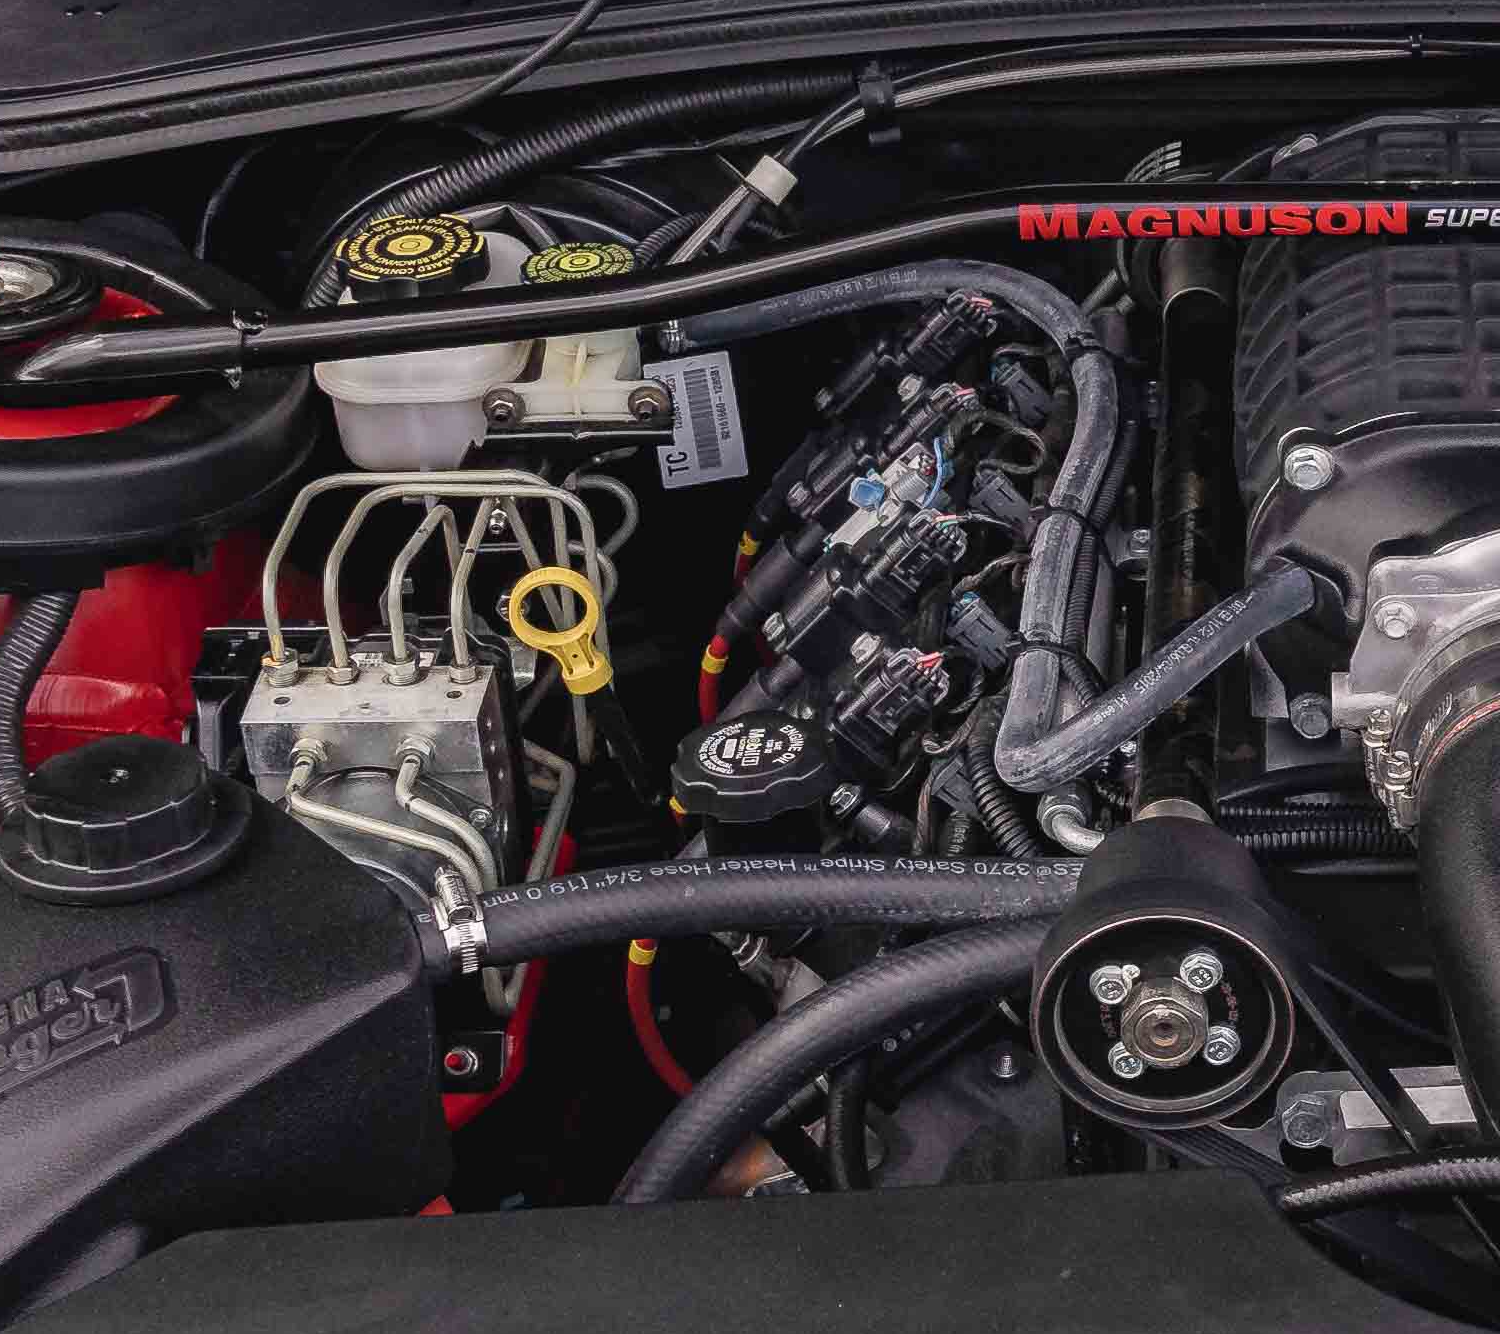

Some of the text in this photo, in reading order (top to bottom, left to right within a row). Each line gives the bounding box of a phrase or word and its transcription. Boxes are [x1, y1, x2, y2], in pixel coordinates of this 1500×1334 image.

[396, 218, 423, 226] ONLY
[1018, 202, 1408, 241] MAGNUSON
[388, 225, 419, 236] CLEAN
[665, 451, 690, 477] TC
[744, 728, 766, 756] Mobil
[772, 724, 804, 764] ENGINE OIL
[650, 861, 713, 876] Hose
[718, 857, 797, 873] Heater
[895, 857, 966, 875] Safety
[974, 861, 1031, 876] 3270
